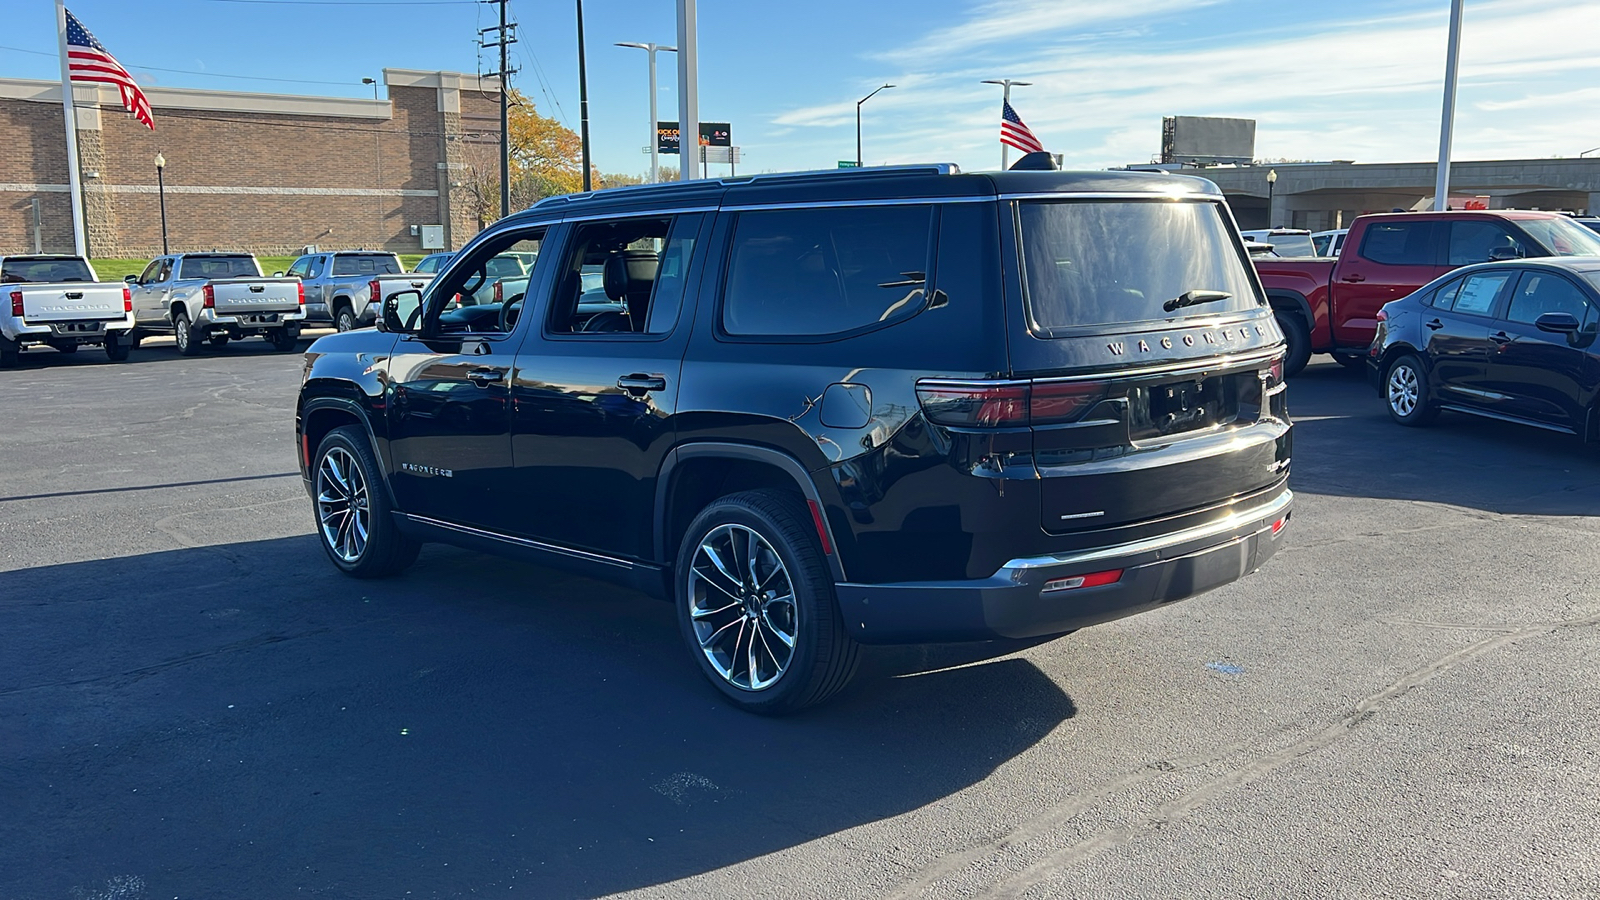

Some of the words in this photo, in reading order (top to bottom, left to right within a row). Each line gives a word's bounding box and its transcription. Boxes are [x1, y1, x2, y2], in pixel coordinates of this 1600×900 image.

[40, 303, 111, 312] TACOMA
[1107, 324, 1266, 356] WAGONEER
[402, 462, 446, 477] WAGONEER
